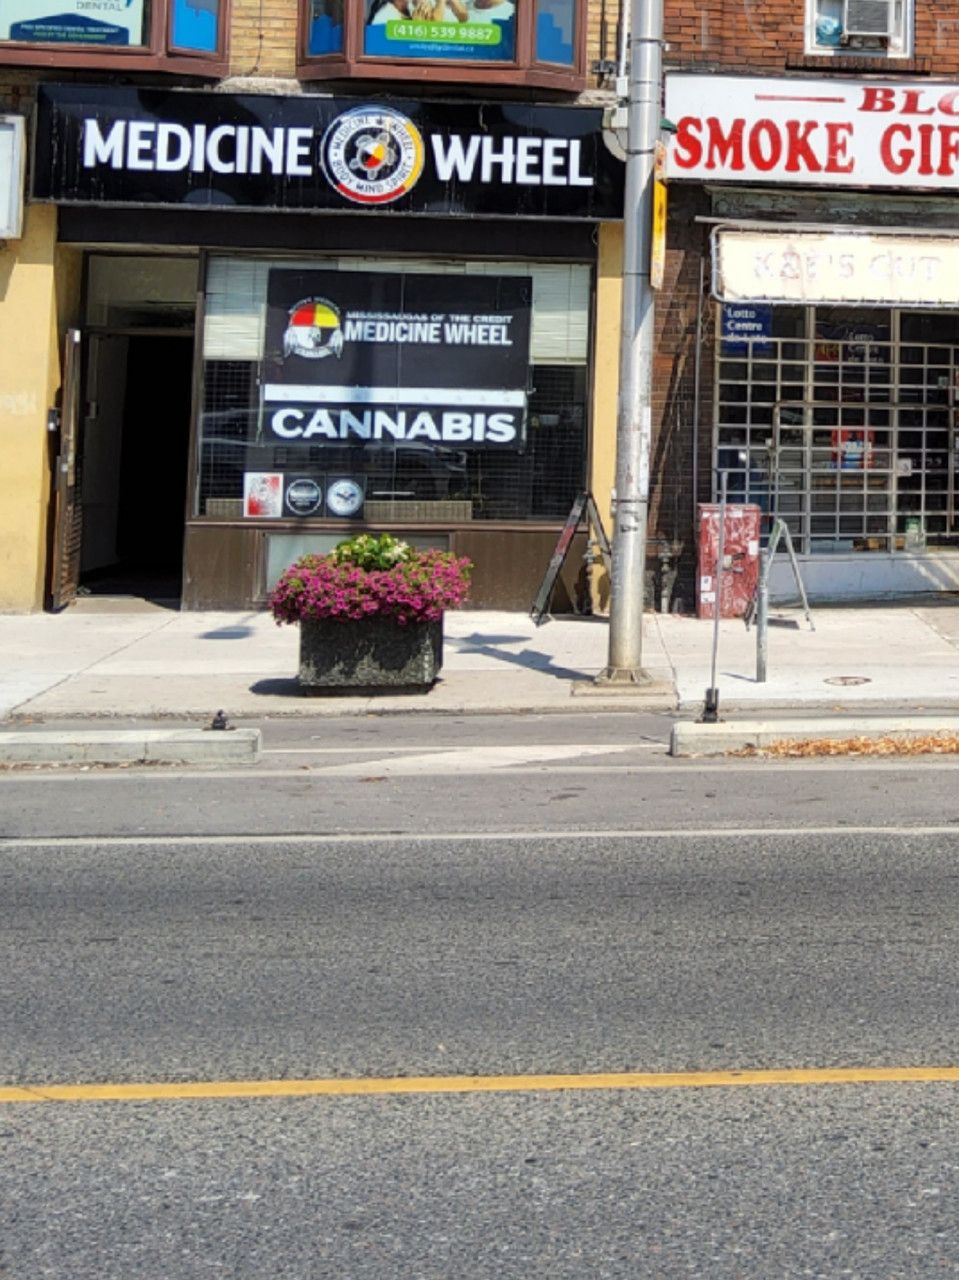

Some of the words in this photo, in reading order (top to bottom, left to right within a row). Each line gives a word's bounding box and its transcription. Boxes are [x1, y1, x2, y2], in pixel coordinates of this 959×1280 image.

[76, 1, 123, 12] DENTAL
[393, 24, 428, 38] (416)
[431, 26, 456, 39] 539
[459, 28, 493, 41] 9887
[84, 117, 313, 178] MEDICINE
[431, 132, 594, 187] WHEEL
[673, 116, 855, 174] SMOKE
[430, 313, 445, 322] OF
[451, 314, 472, 323] THE
[474, 315, 513, 324] CREDIT
[727, 307, 757, 319] Lotto
[344, 321, 441, 344] MEDICINE
[444, 323, 513, 345] WHEEL
[727, 321, 763, 332] Centre
[270, 407, 517, 443] CANNABIS
